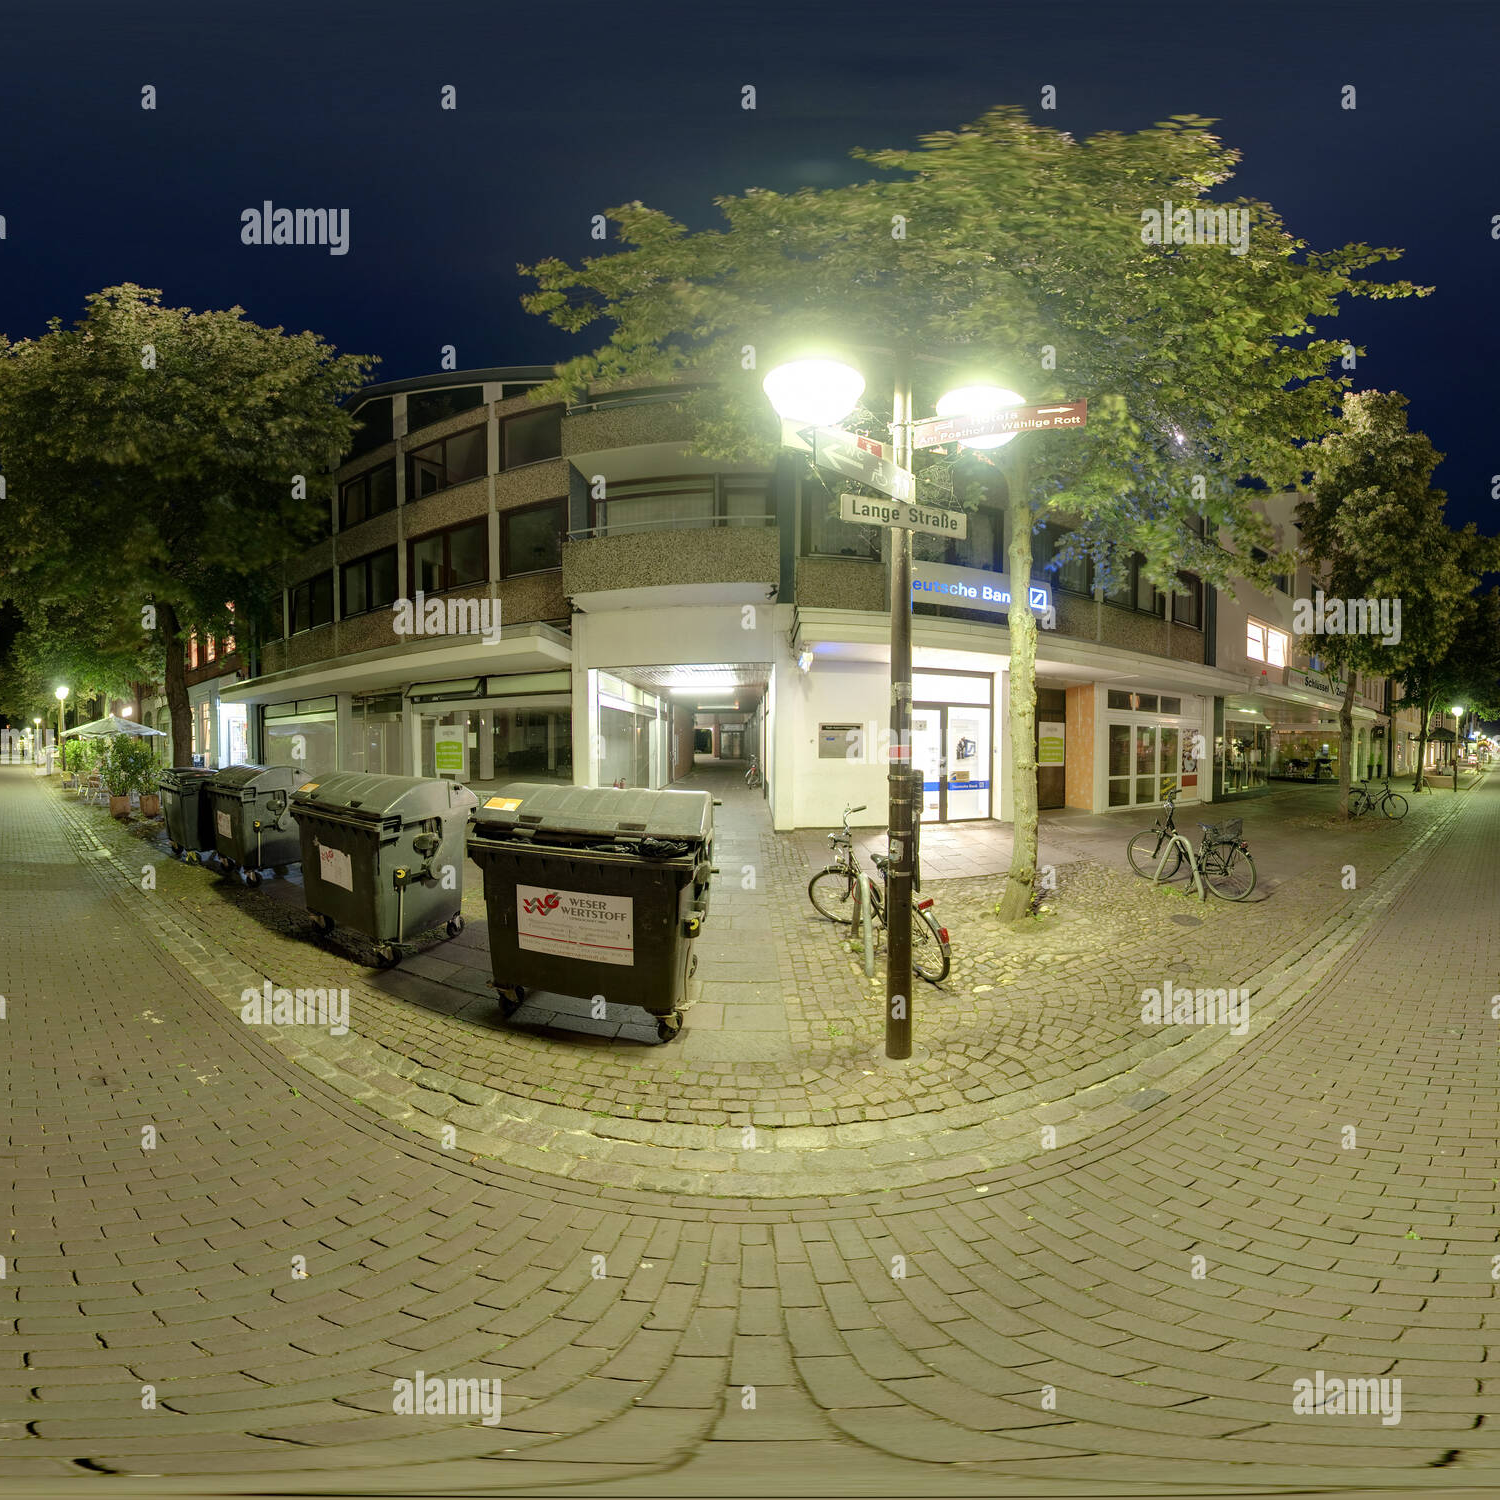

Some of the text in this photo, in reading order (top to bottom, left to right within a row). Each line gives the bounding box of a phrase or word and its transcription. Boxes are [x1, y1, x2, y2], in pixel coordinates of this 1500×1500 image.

[919, 437, 937, 445] Am
[940, 426, 986, 439] Posthof
[1054, 416, 1081, 425] Rott
[846, 445, 865, 461] WC
[852, 500, 958, 530] Lange Straße
[912, 579, 1011, 604] eutsche Ban
[561, 906, 627, 922] WERTSTOFF
[569, 897, 607, 911] WESER
